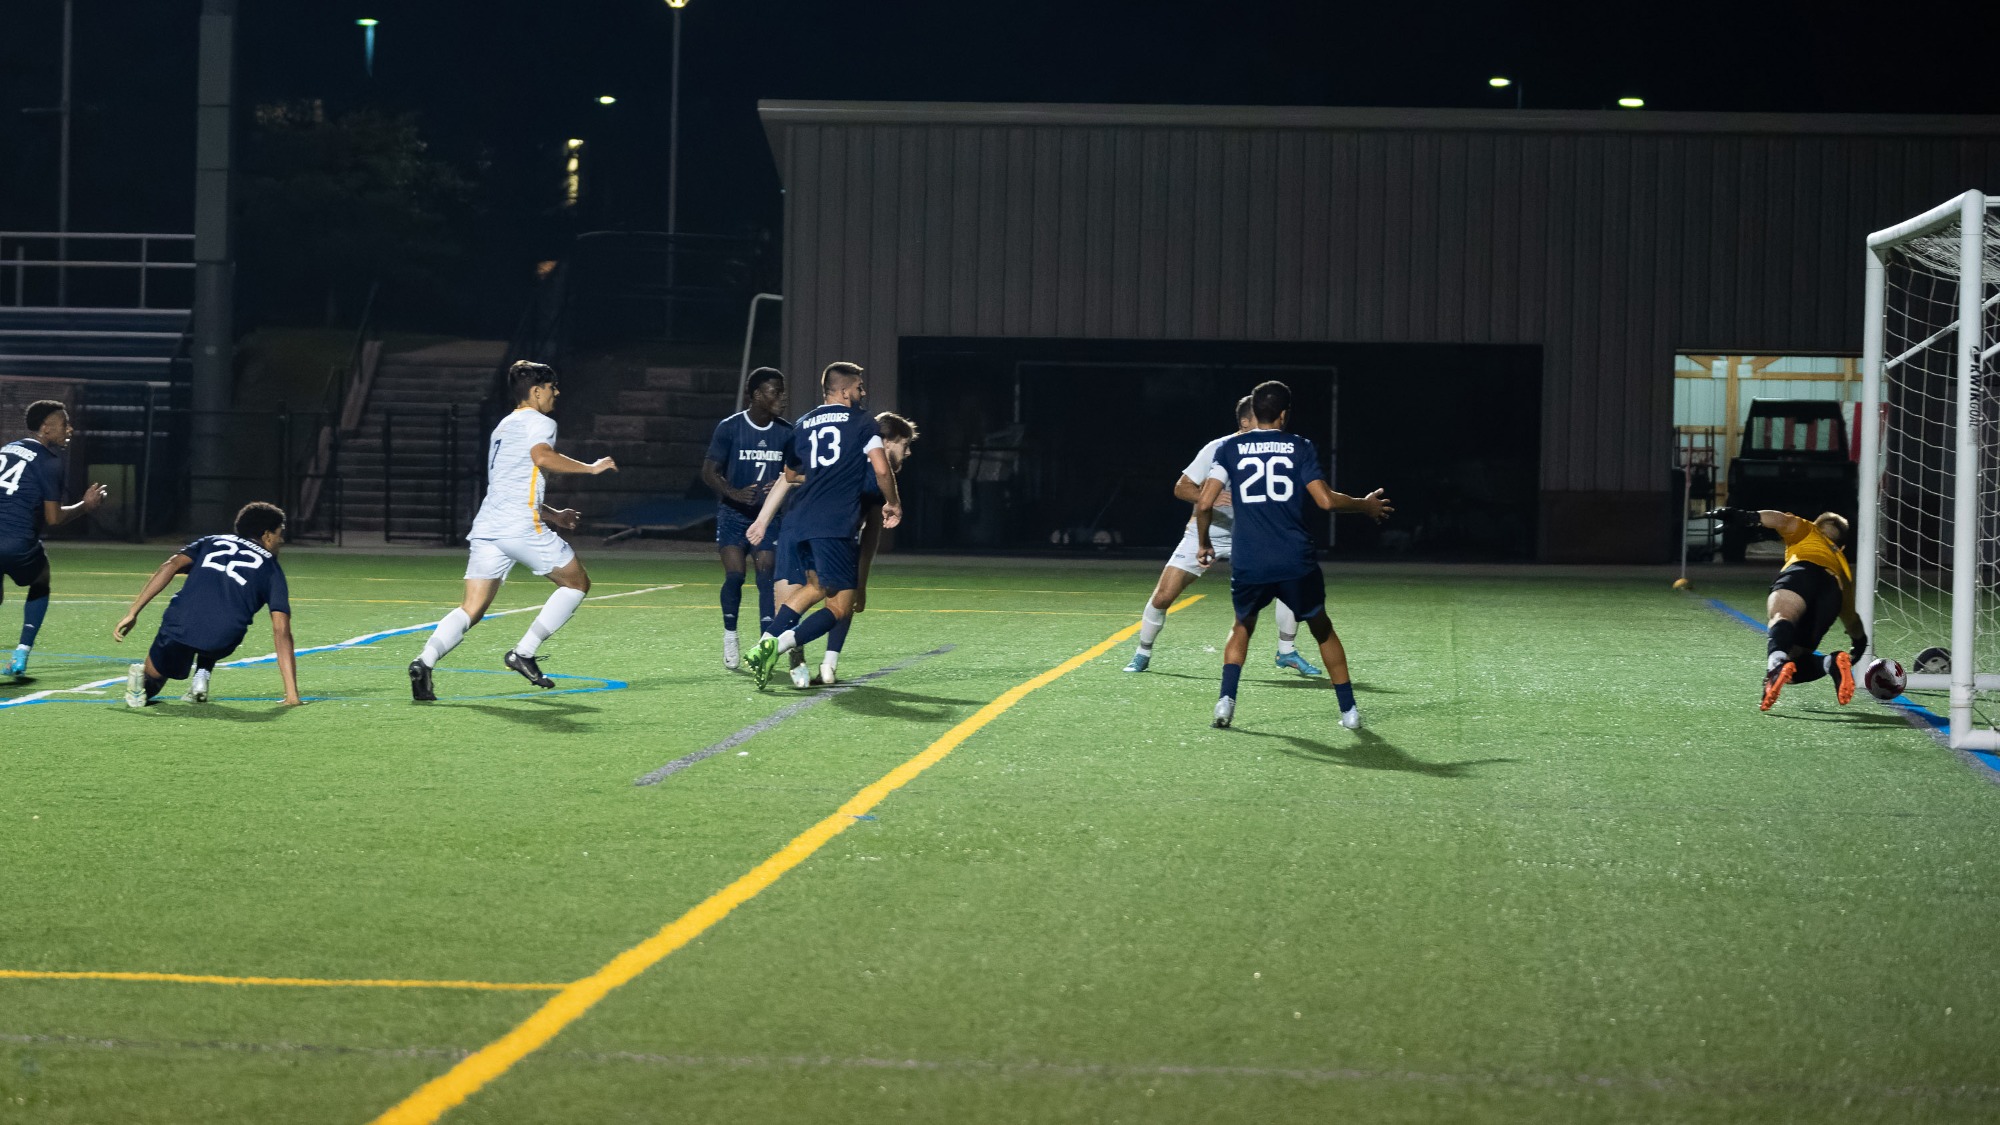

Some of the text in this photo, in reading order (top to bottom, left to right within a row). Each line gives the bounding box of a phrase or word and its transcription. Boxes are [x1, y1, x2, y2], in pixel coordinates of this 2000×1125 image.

[802, 412, 850, 430] WARRIORS
[738, 449, 784, 462] LYCOMING
[808, 425, 841, 468] 13
[1236, 441, 1295, 455] WARRIORS
[755, 461, 767, 482] 7
[1236, 455, 1295, 503] 26
[201, 540, 264, 586] 22
